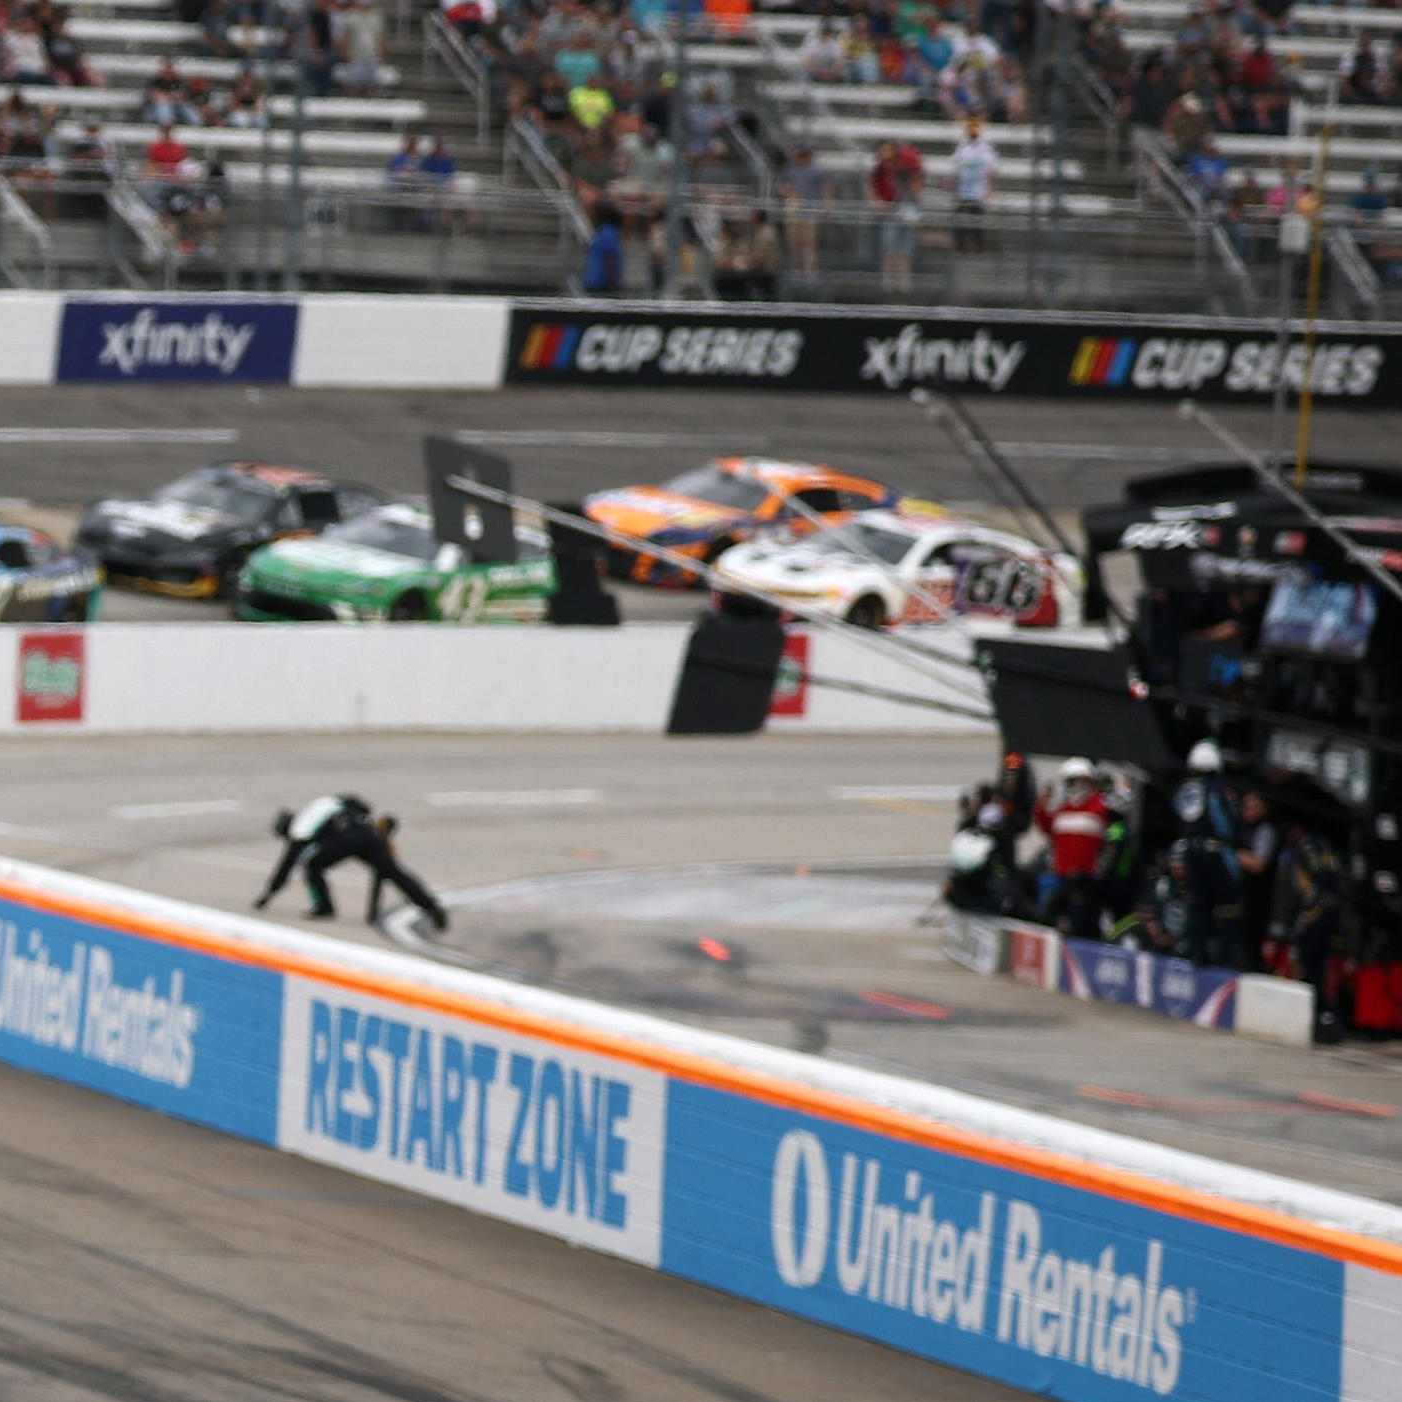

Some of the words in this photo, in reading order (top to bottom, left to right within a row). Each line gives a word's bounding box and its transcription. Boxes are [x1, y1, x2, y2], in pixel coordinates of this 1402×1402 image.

[98, 307, 256, 375] xfinity
[574, 326, 655, 372] CUP
[657, 324, 805, 377] SERIES
[859, 323, 1028, 388] xfinity
[1130, 338, 1226, 393] CUP
[1225, 341, 1385, 398] SERIES
[83, 944, 195, 1090] Rentals
[305, 998, 495, 1188] RESTART
[502, 1050, 632, 1232] ZONE
[835, 1152, 997, 1336] United
[997, 1199, 1187, 1397] Rentals
